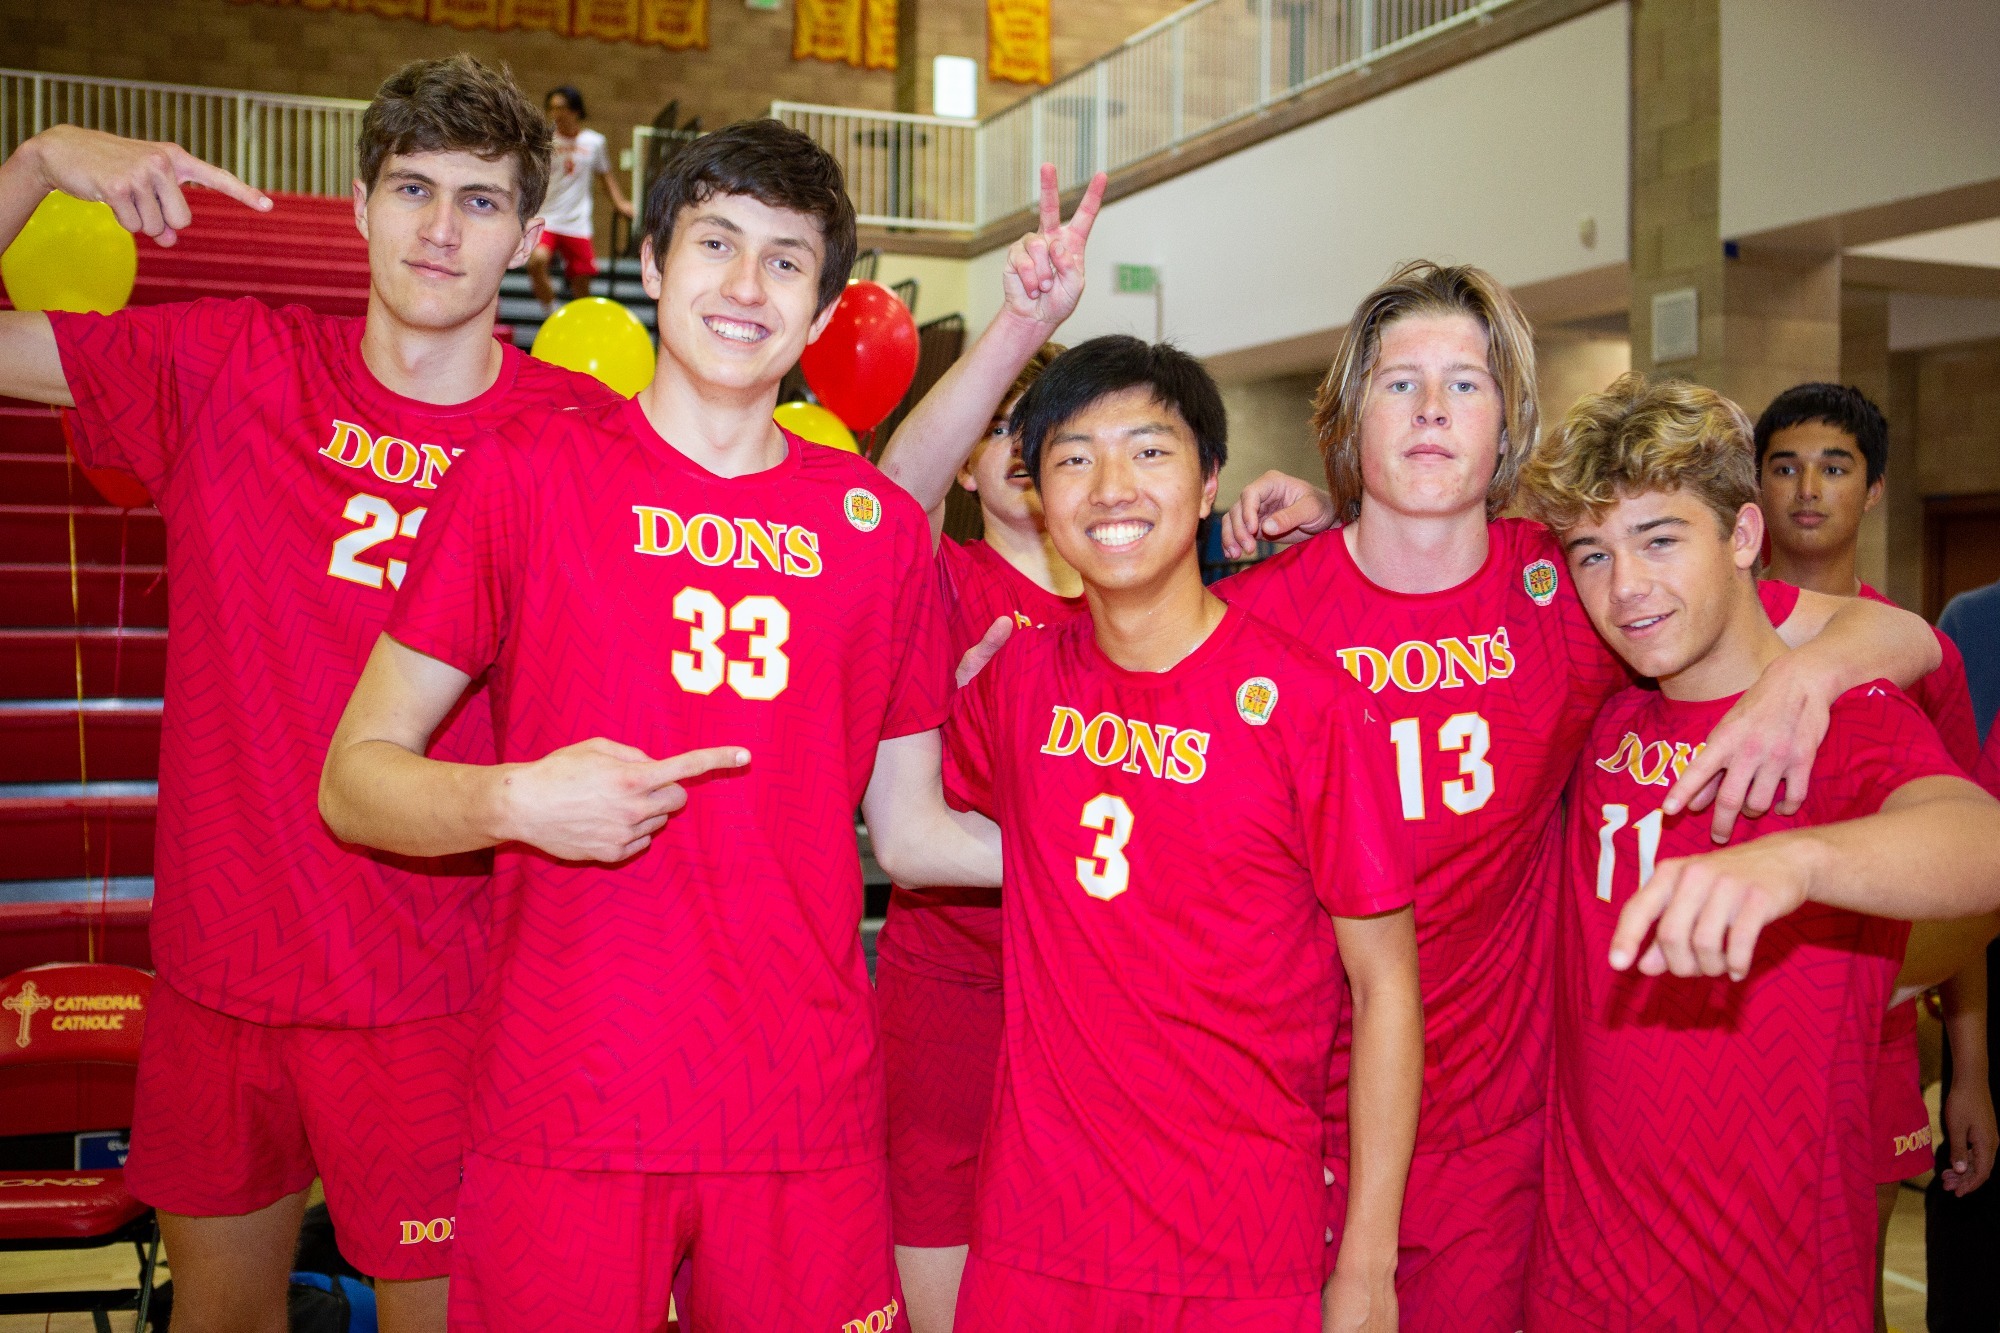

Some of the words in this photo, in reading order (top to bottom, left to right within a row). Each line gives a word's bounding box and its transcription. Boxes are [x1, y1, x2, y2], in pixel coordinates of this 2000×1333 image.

[632, 505, 822, 577] DONS
[671, 586, 790, 701] 33
[1336, 626, 1515, 694] DONS
[1040, 705, 1210, 784] DONS
[1390, 711, 1495, 820] 13
[1075, 792, 1135, 901] 3
[1596, 803, 1664, 903] 11
[51, 1014, 125, 1031] CATHOLIC
[53, 994, 143, 1011] CATHEDRAL
[399, 1216, 456, 1245] DO
